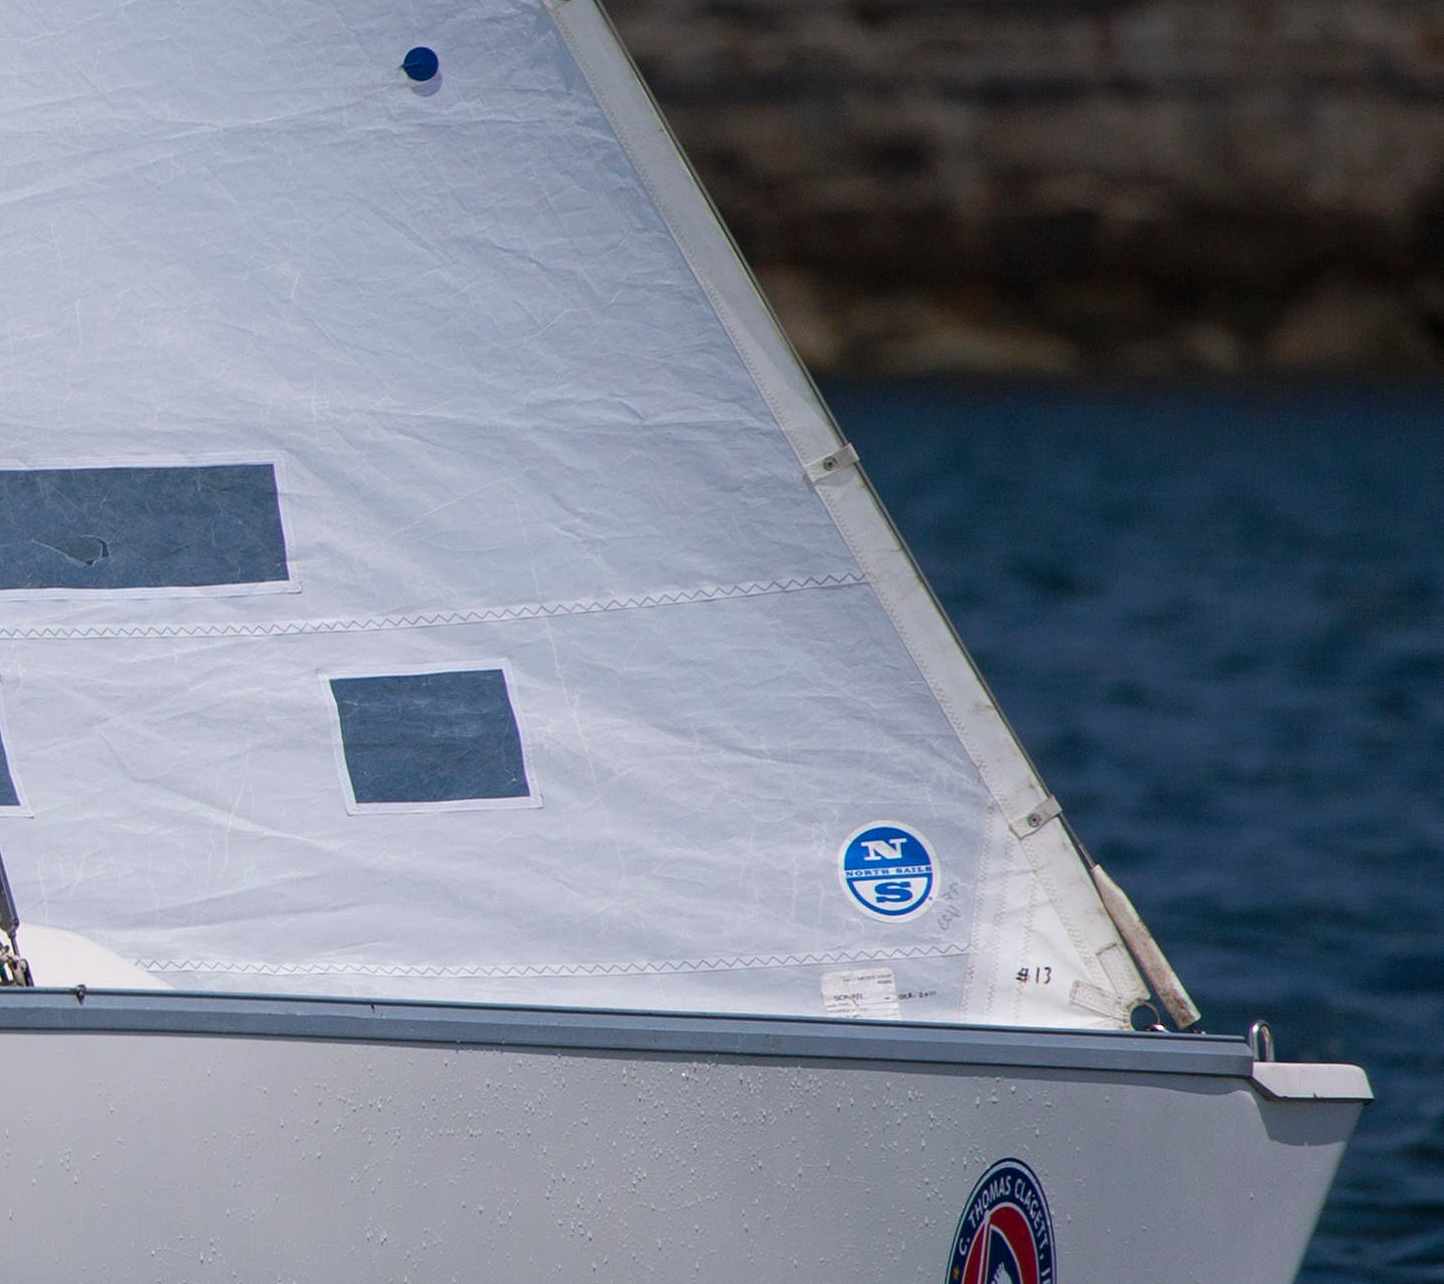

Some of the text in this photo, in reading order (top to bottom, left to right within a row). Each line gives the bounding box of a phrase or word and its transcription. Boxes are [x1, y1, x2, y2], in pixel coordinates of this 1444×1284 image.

[860, 838, 907, 860] N
[846, 865, 933, 877] NORTH SAILS
[874, 882, 913, 903] S
[968, 1175, 1012, 1228] THOMAS
